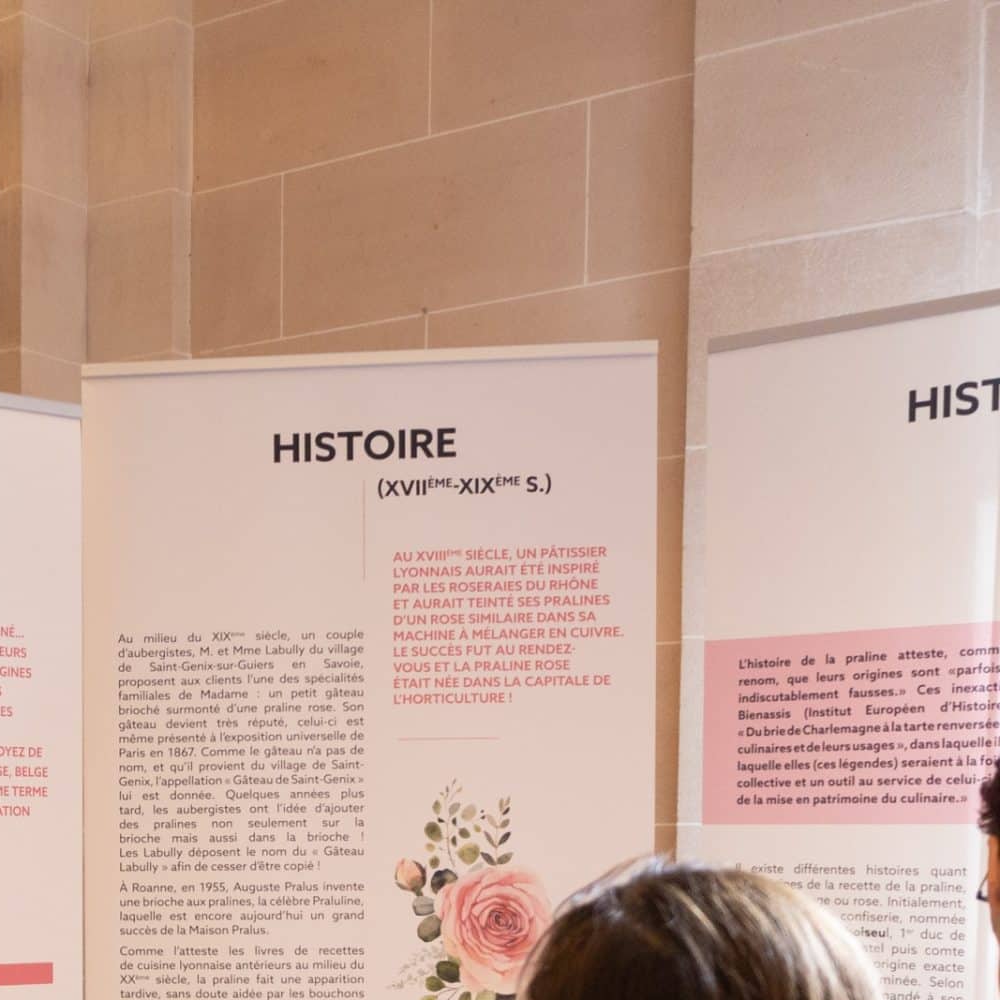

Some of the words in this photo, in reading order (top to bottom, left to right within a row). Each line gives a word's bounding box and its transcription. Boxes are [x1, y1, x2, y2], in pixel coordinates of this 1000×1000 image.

[273, 427, 456, 463] HISTOIRE
[526, 473, 551, 494] S.)
[393, 565, 462, 578] LYONNAIS
[465, 564, 516, 576] AURAIT
[520, 561, 544, 575] ÉTÉ
[548, 560, 599, 575] INSPIRÉ
[393, 583, 419, 594] PAR
[423, 582, 446, 594] LES
[449, 580, 522, 592] ROSERAIES
[526, 580, 546, 591] DU
[549, 576, 598, 591] RHÔNE
[117, 633, 133, 643] Au
[143, 632, 176, 643] milieu
[187, 632, 202, 642] du
[256, 629, 290, 641] siècle,
[301, 632, 315, 640] un
[326, 628, 364, 641] couple
[118, 661, 132, 672] de
[149, 659, 274, 672] Saint-Genix-sur-Guiers
[292, 661, 306, 669] en
[324, 658, 363, 669] Savoie,
[801, 655, 815, 666] de
[825, 653, 835, 664] la
[846, 651, 887, 666] praline
[898, 648, 947, 660] atteste,
[393, 661, 431, 673] VOUS
[434, 661, 450, 672] ET
[453, 661, 471, 672] LA
[474, 659, 531, 672] PRALINE
[534, 659, 570, 670] ROSE
[738, 677, 779, 686] renom,
[786, 675, 808, 686] que
[816, 671, 845, 682] leurs
[852, 668, 902, 682] origines
[911, 667, 940, 677] sont
[736, 794, 750, 805] de
[753, 794, 763, 805] la
[766, 794, 793, 804] mise
[795, 796, 810, 804] en
[812, 793, 878, 807] patrimoine
[881, 792, 897, 803] du
[751, 864, 784, 875] existe
[793, 862, 856, 875] différentes
[866, 864, 919, 876] histoires
[930, 867, 966, 878] quant
[120, 879, 127, 893] À
[132, 882, 176, 893] Roanne,
[181, 884, 194, 892] en
[200, 881, 228, 893] 1955,
[234, 881, 280, 894] Auguste
[285, 881, 318, 891] Pralus
[323, 881, 364, 891] invente
[853, 897, 880, 906] rose.
[888, 896, 966, 910] Initialement,
